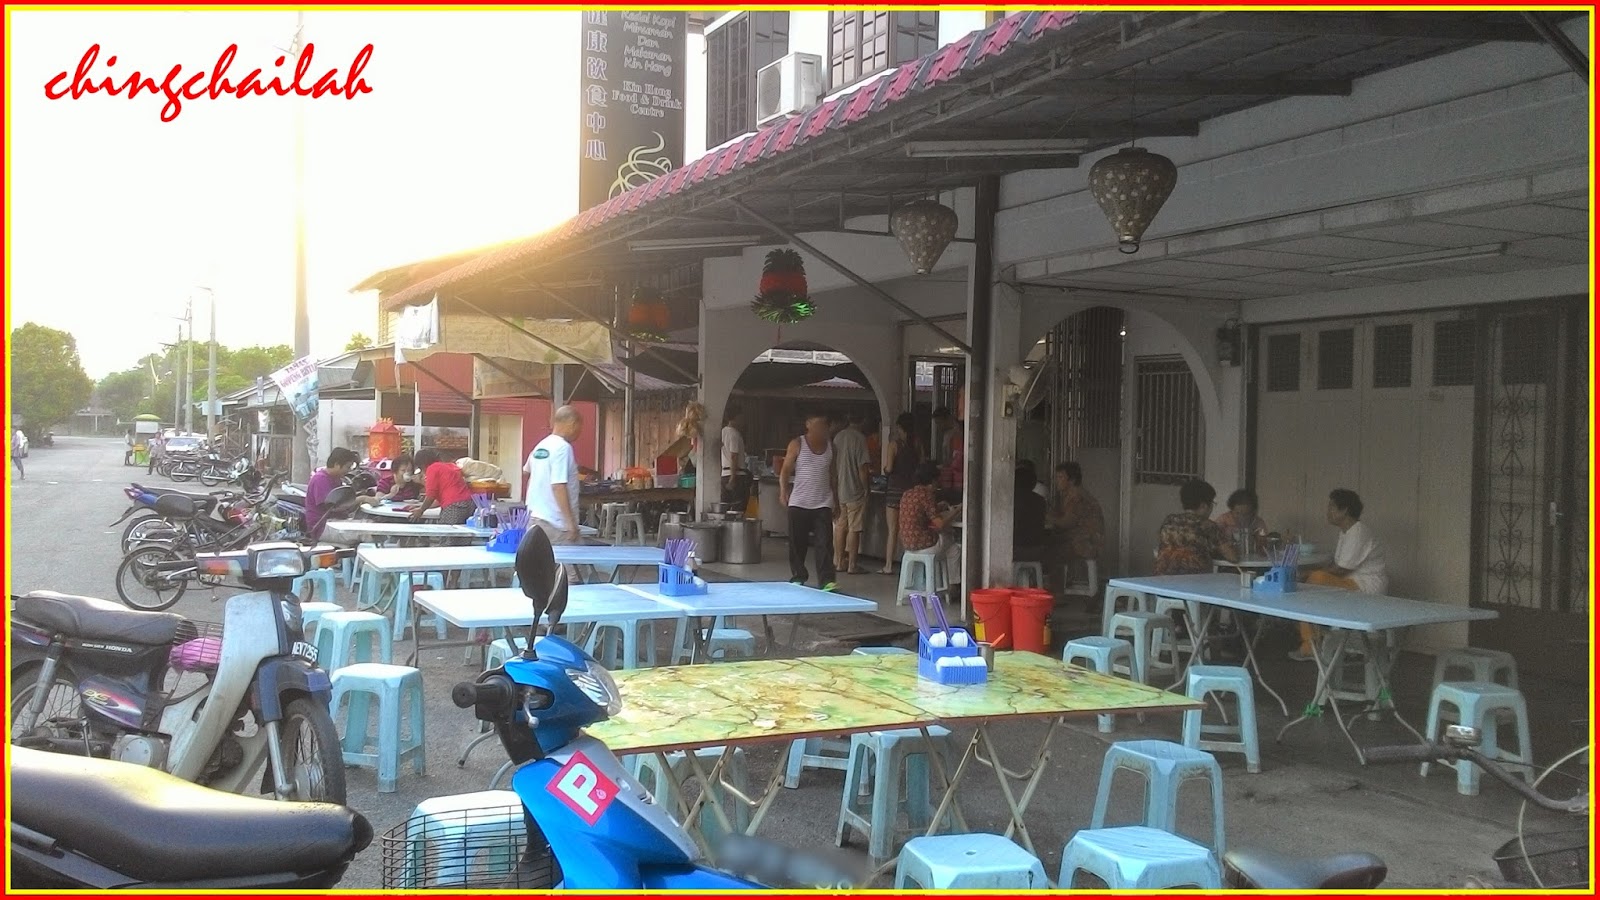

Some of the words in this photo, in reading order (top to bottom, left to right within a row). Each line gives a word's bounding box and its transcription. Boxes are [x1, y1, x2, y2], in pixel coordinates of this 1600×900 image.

[623, 20, 674, 40] Minuman
[652, 14, 677, 30] Kopi
[637, 35, 660, 49] Dan
[623, 45, 673, 63] Makanan
[623, 56, 644, 70] Kin
[644, 59, 673, 78] Hong
[612, 89, 638, 104] Food
[640, 94, 650, 106] &
[652, 95, 683, 110] Drink
[623, 80, 642, 94] Kin
[644, 83, 672, 101] Hong
[630, 103, 665, 118] Centre
[105, 644, 133, 653] HONDA
[556, 762, 600, 816] P
